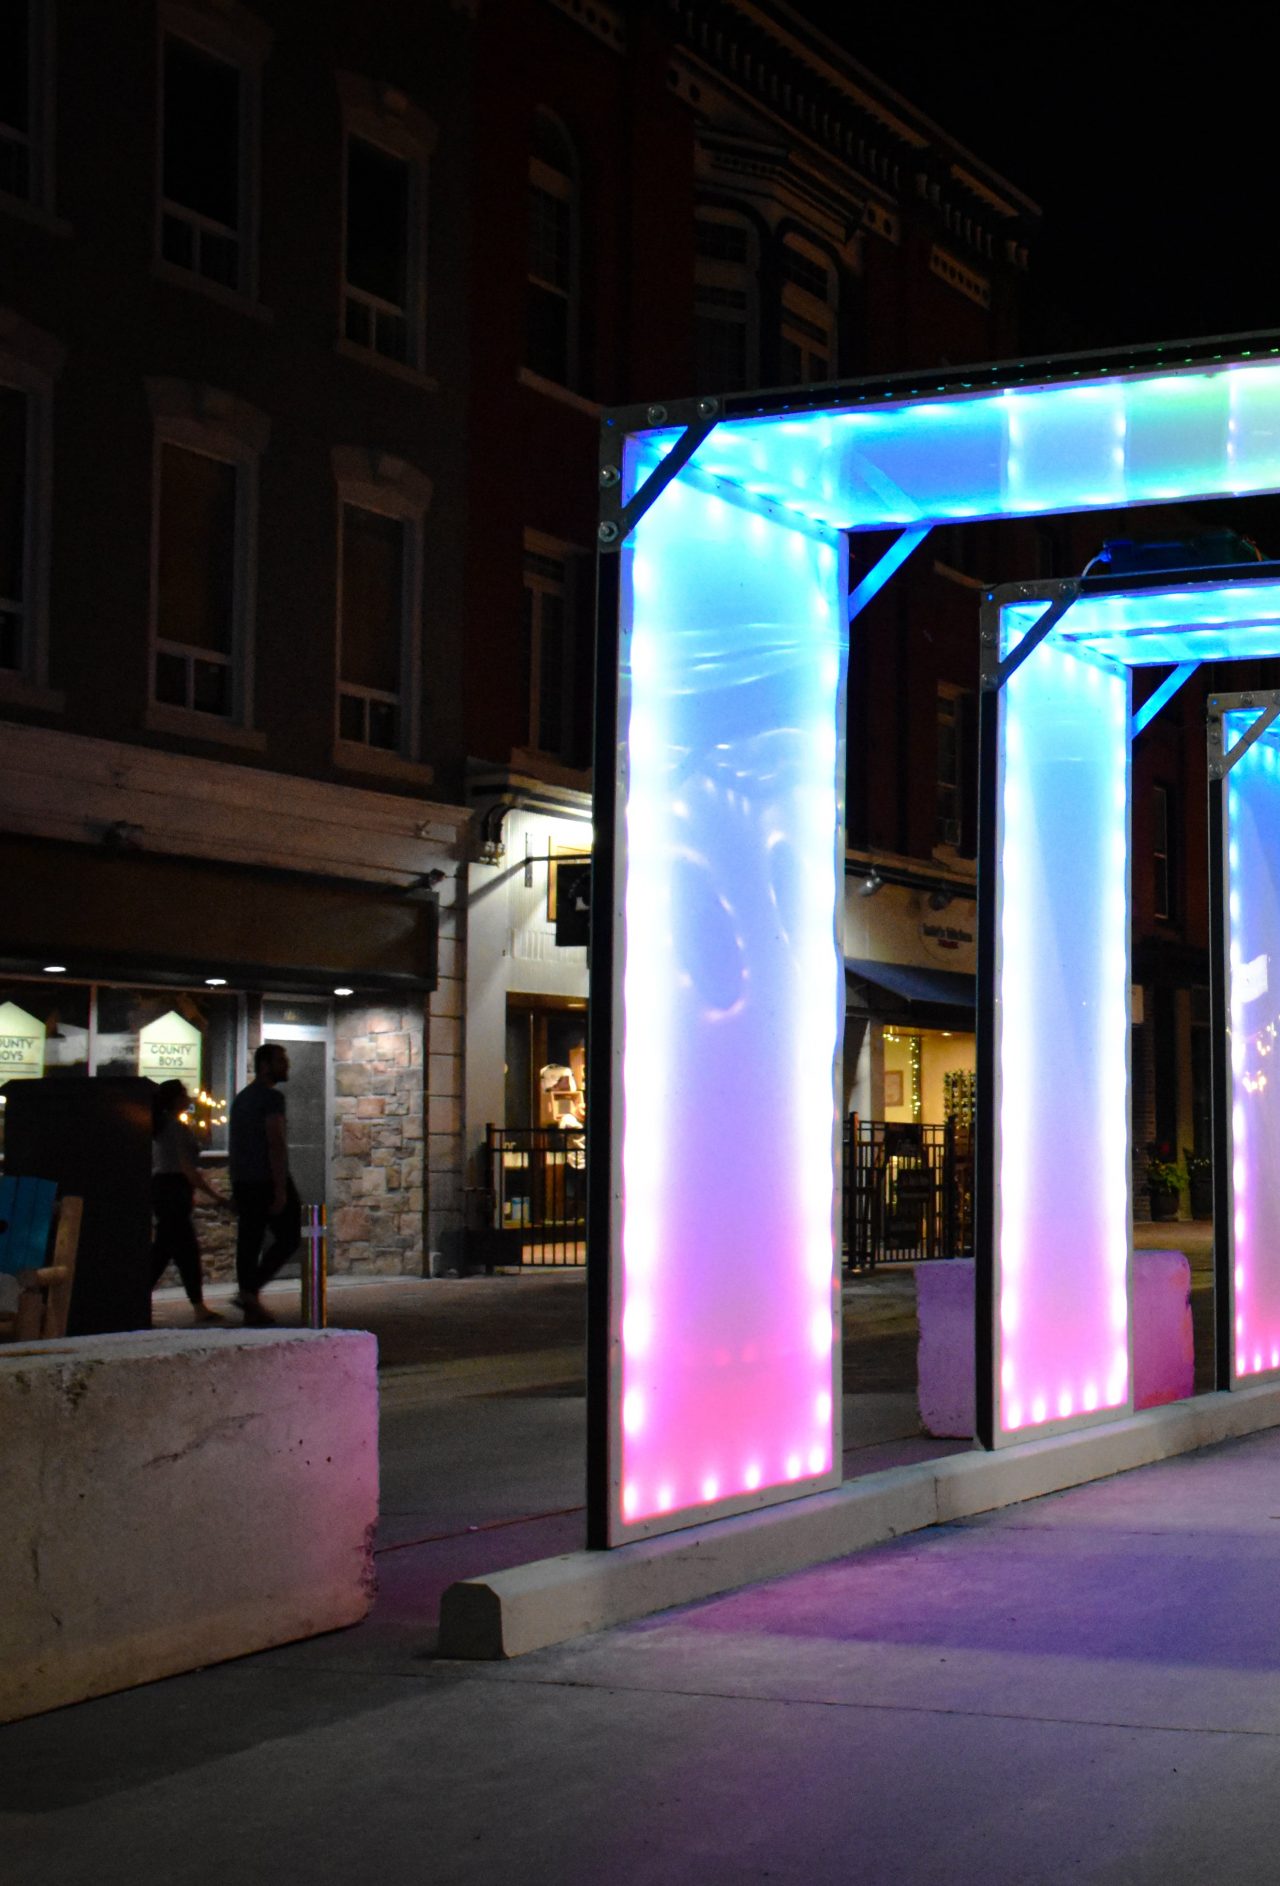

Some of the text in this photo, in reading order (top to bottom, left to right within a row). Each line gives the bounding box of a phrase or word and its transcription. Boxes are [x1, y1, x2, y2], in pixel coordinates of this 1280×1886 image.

[150, 1044, 192, 1055] COUNTY
[0, 1050, 24, 1061] OYS
[158, 1056, 184, 1066] BOYS
